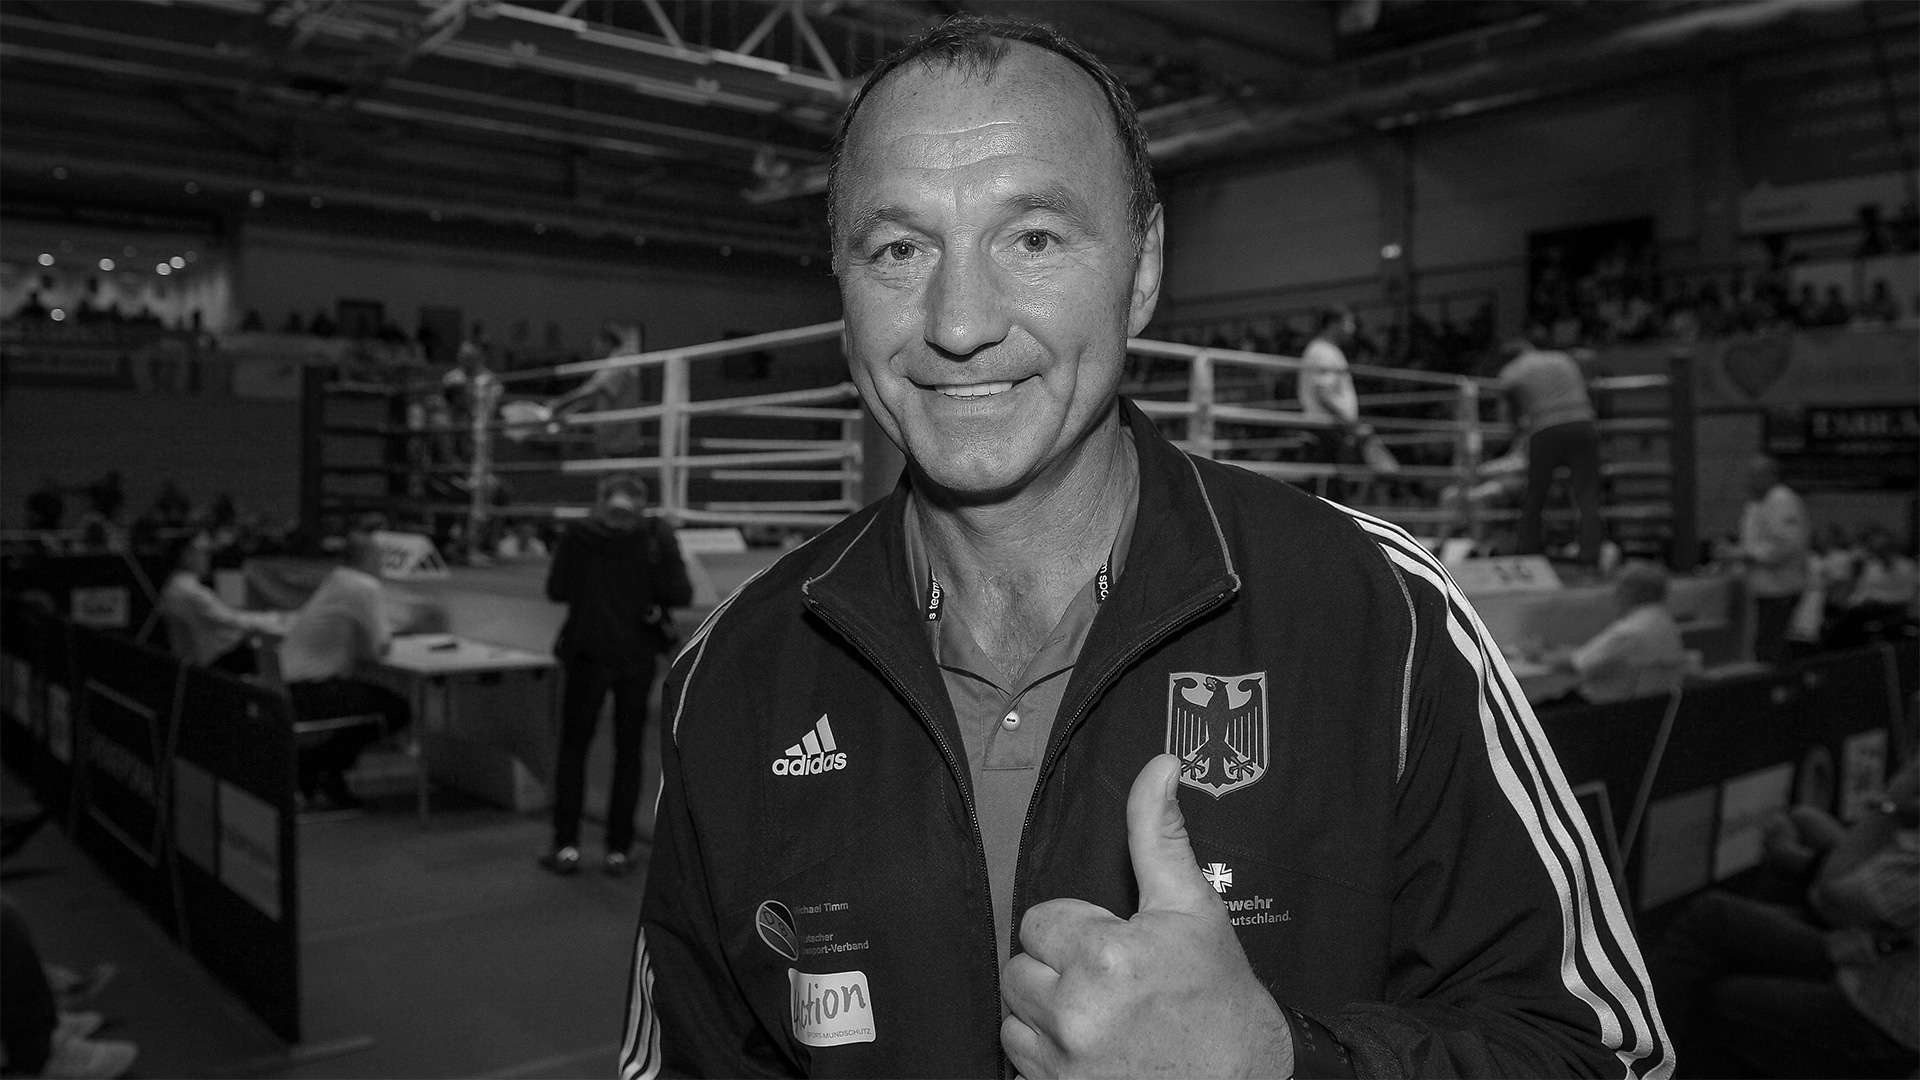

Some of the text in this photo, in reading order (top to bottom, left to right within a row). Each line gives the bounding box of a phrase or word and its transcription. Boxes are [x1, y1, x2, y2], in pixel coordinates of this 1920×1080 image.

[1098, 575, 1109, 600] spo
[772, 752, 847, 776] adidas
[823, 902, 849, 912] Timm
[1230, 910, 1292, 926] utschland.
